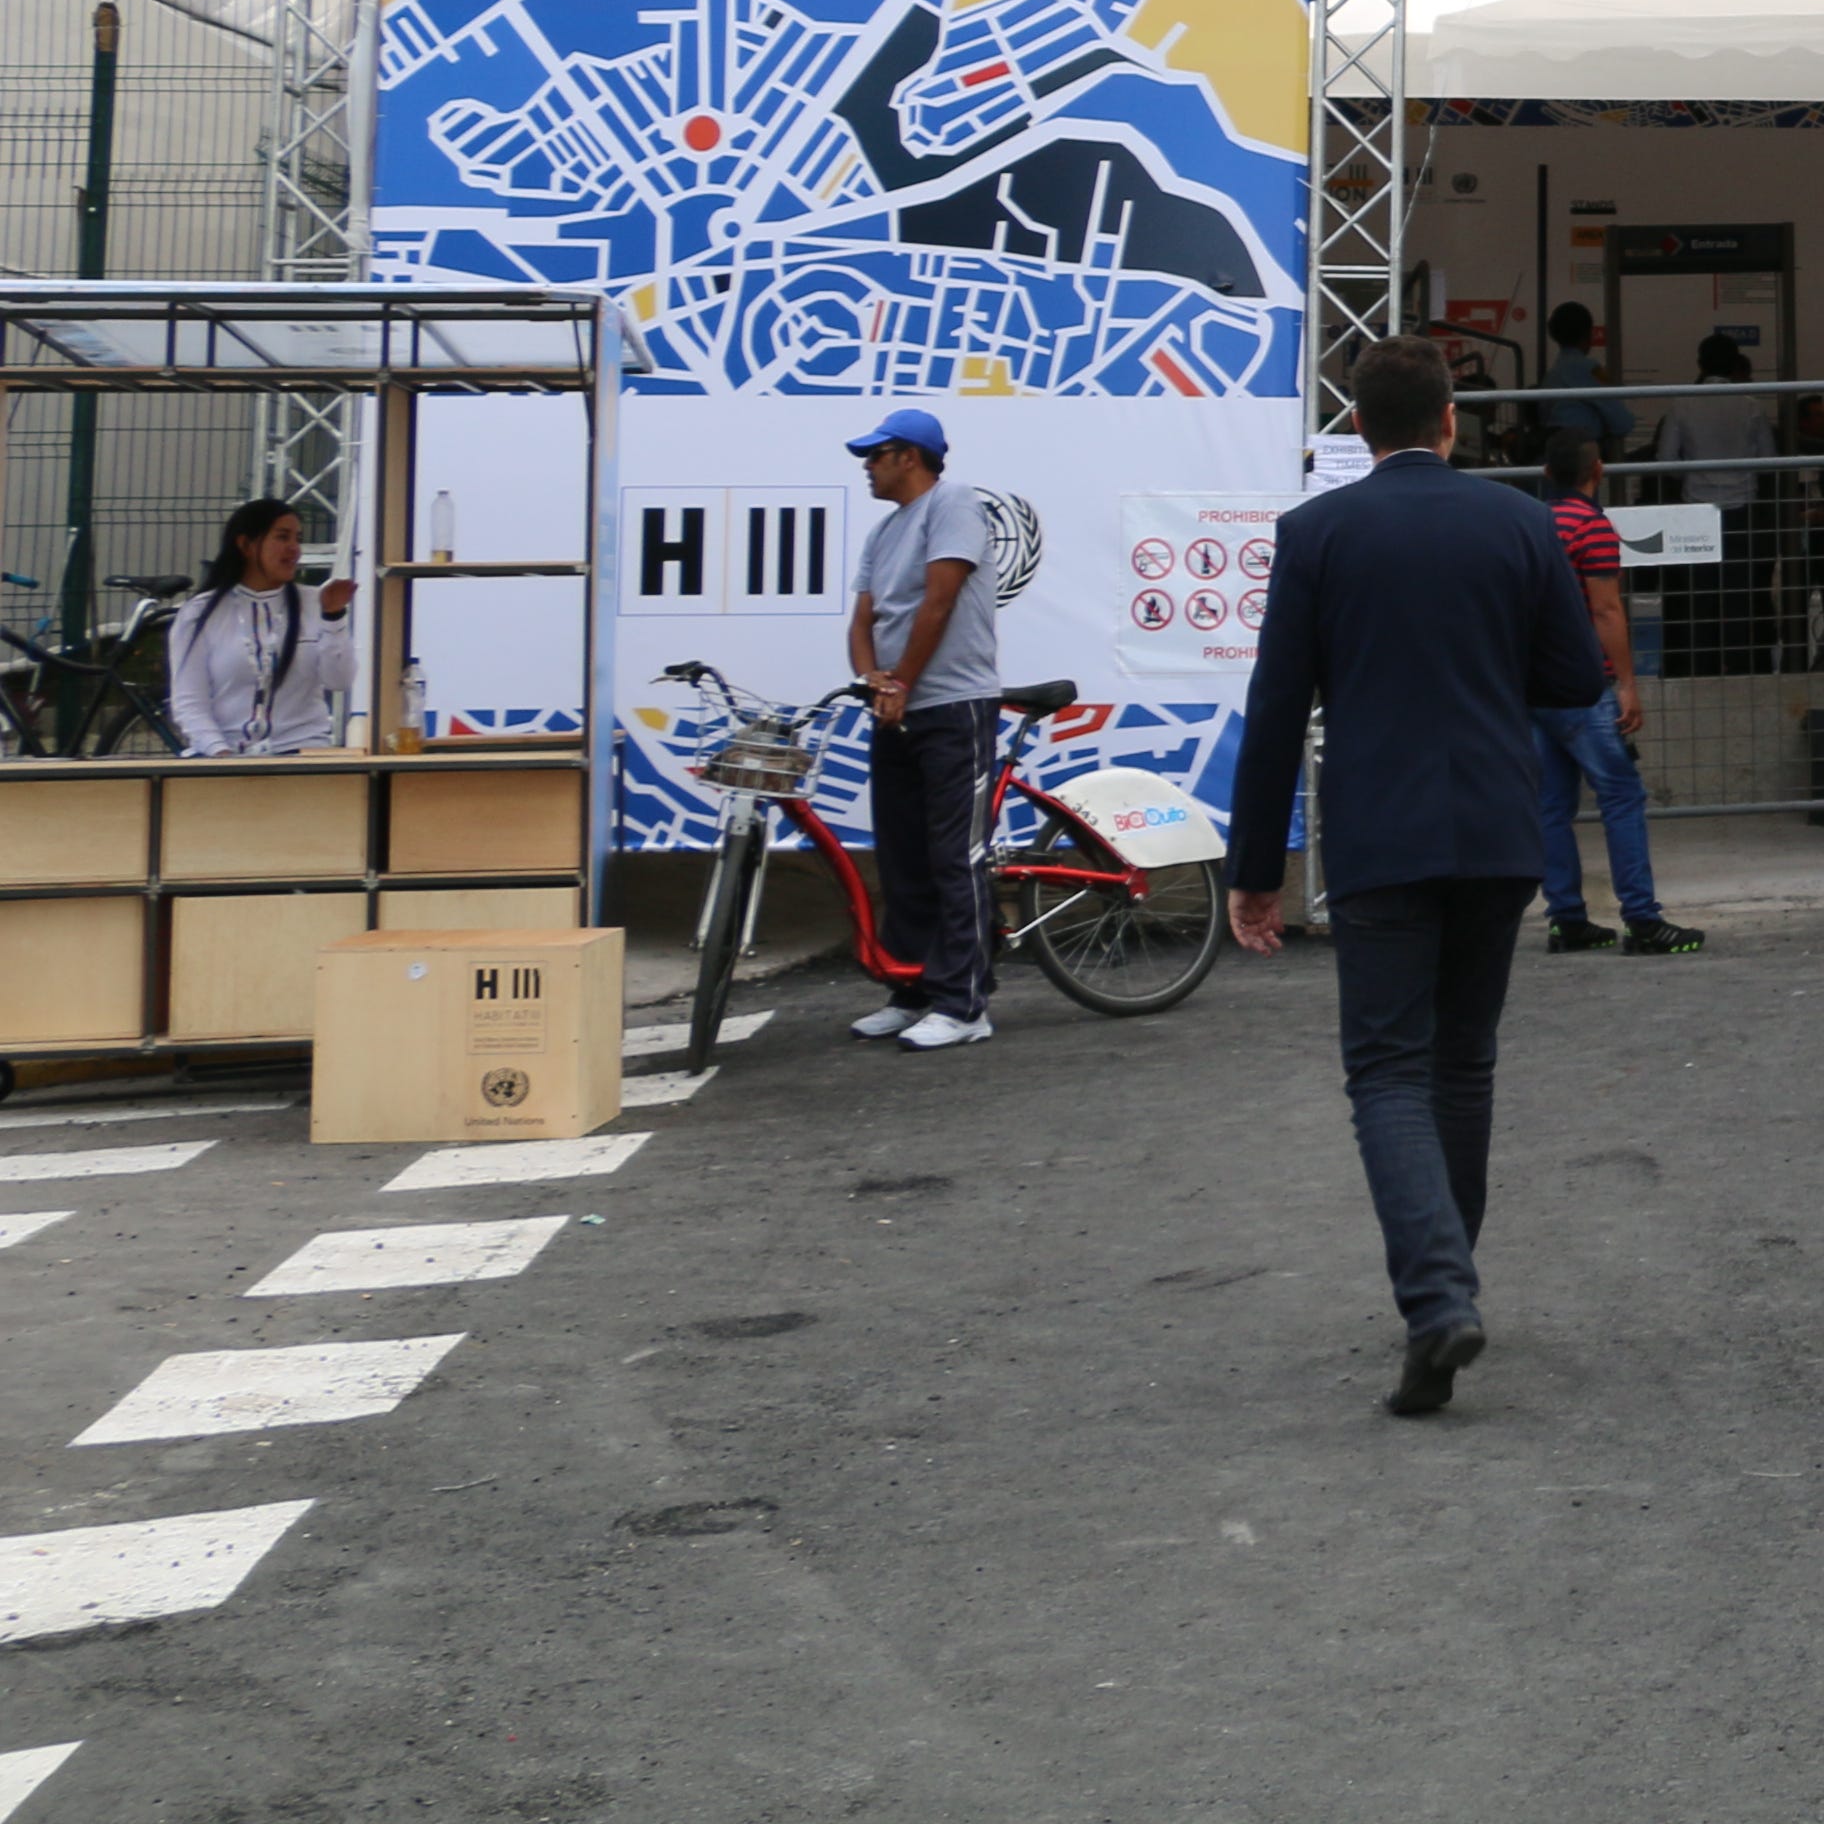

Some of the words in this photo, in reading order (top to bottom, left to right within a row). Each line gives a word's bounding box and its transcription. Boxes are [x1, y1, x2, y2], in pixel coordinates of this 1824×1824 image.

[1690, 238, 1738, 249] Entrada
[642, 507, 704, 596] H
[747, 507, 826, 596] III
[1684, 544, 1716, 553] Interior
[475, 968, 498, 999] H
[512, 968, 540, 999] III
